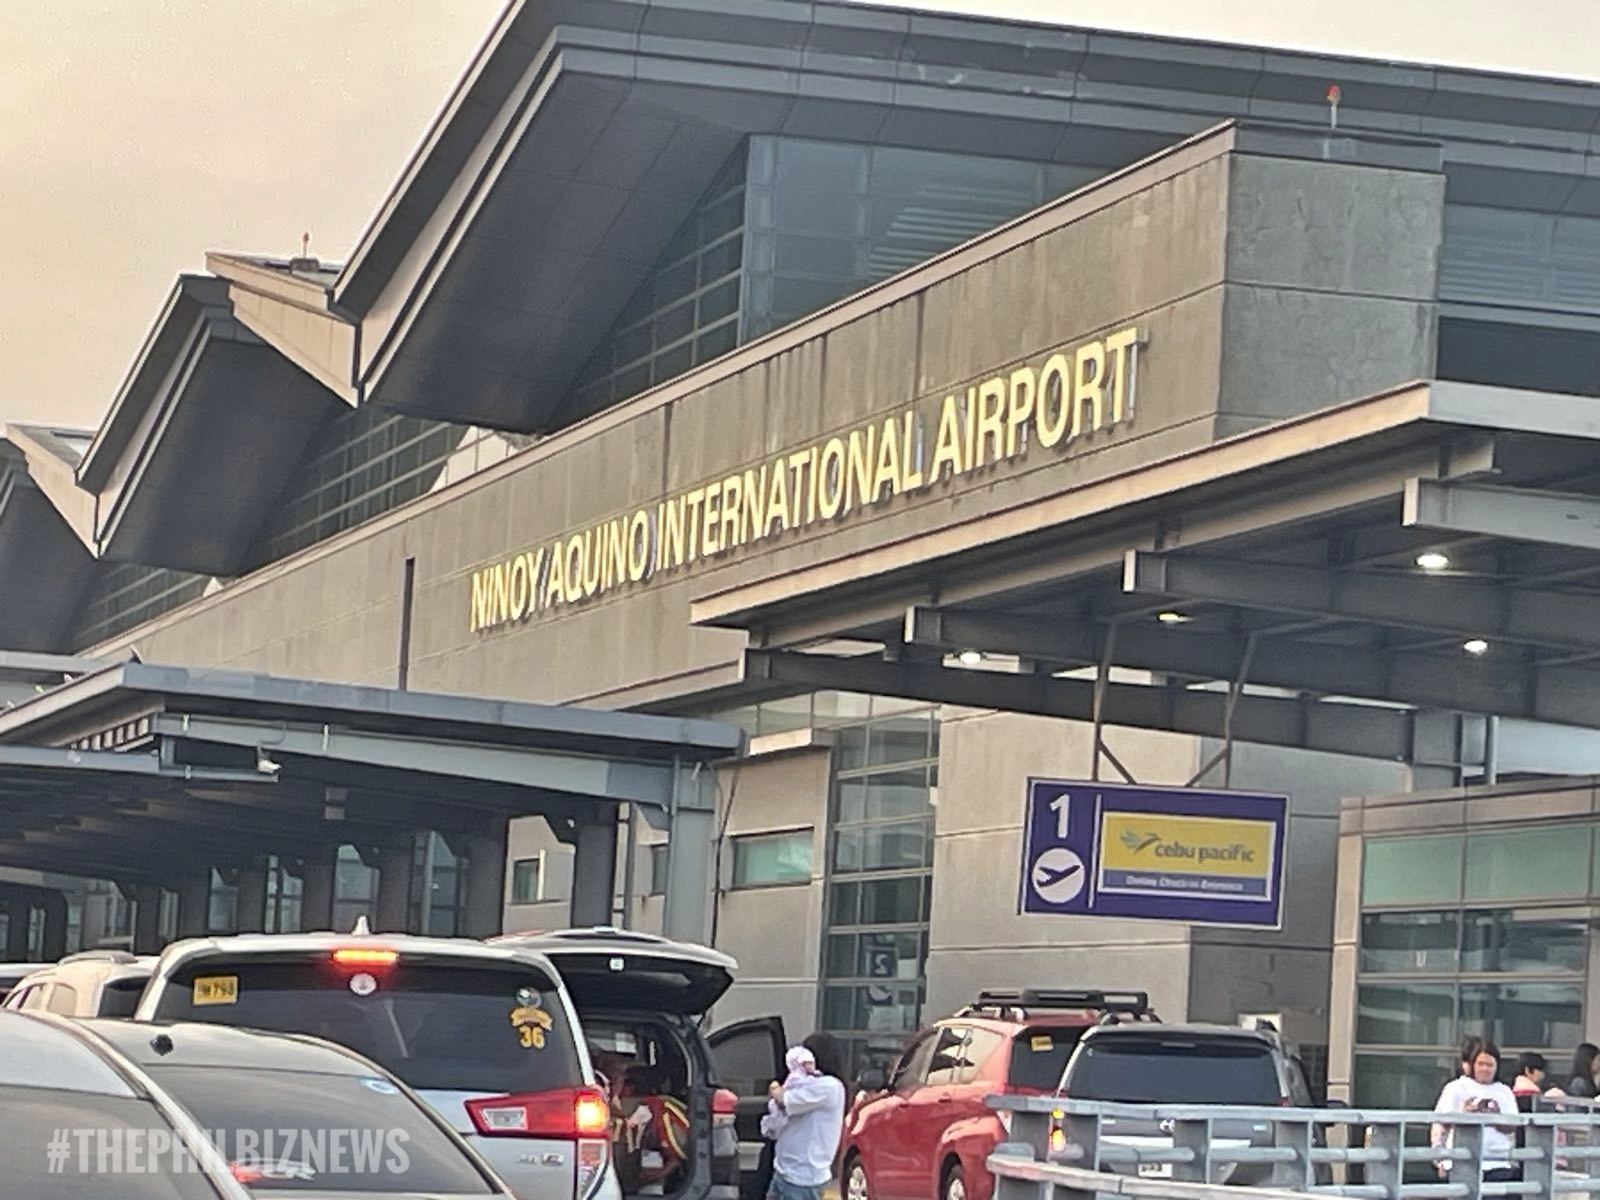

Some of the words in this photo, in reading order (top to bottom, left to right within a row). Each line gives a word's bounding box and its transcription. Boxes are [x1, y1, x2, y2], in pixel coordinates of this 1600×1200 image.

[469, 547, 545, 633] NINOY
[545, 509, 650, 608] AQUINO
[656, 410, 924, 572] INTERNATIONAL
[929, 327, 1140, 484] AIRPORT
[1050, 793, 1070, 838] 1
[1155, 841, 1196, 859] cebu
[1198, 842, 1256, 865] pacific
[519, 1025, 546, 1049] 36
